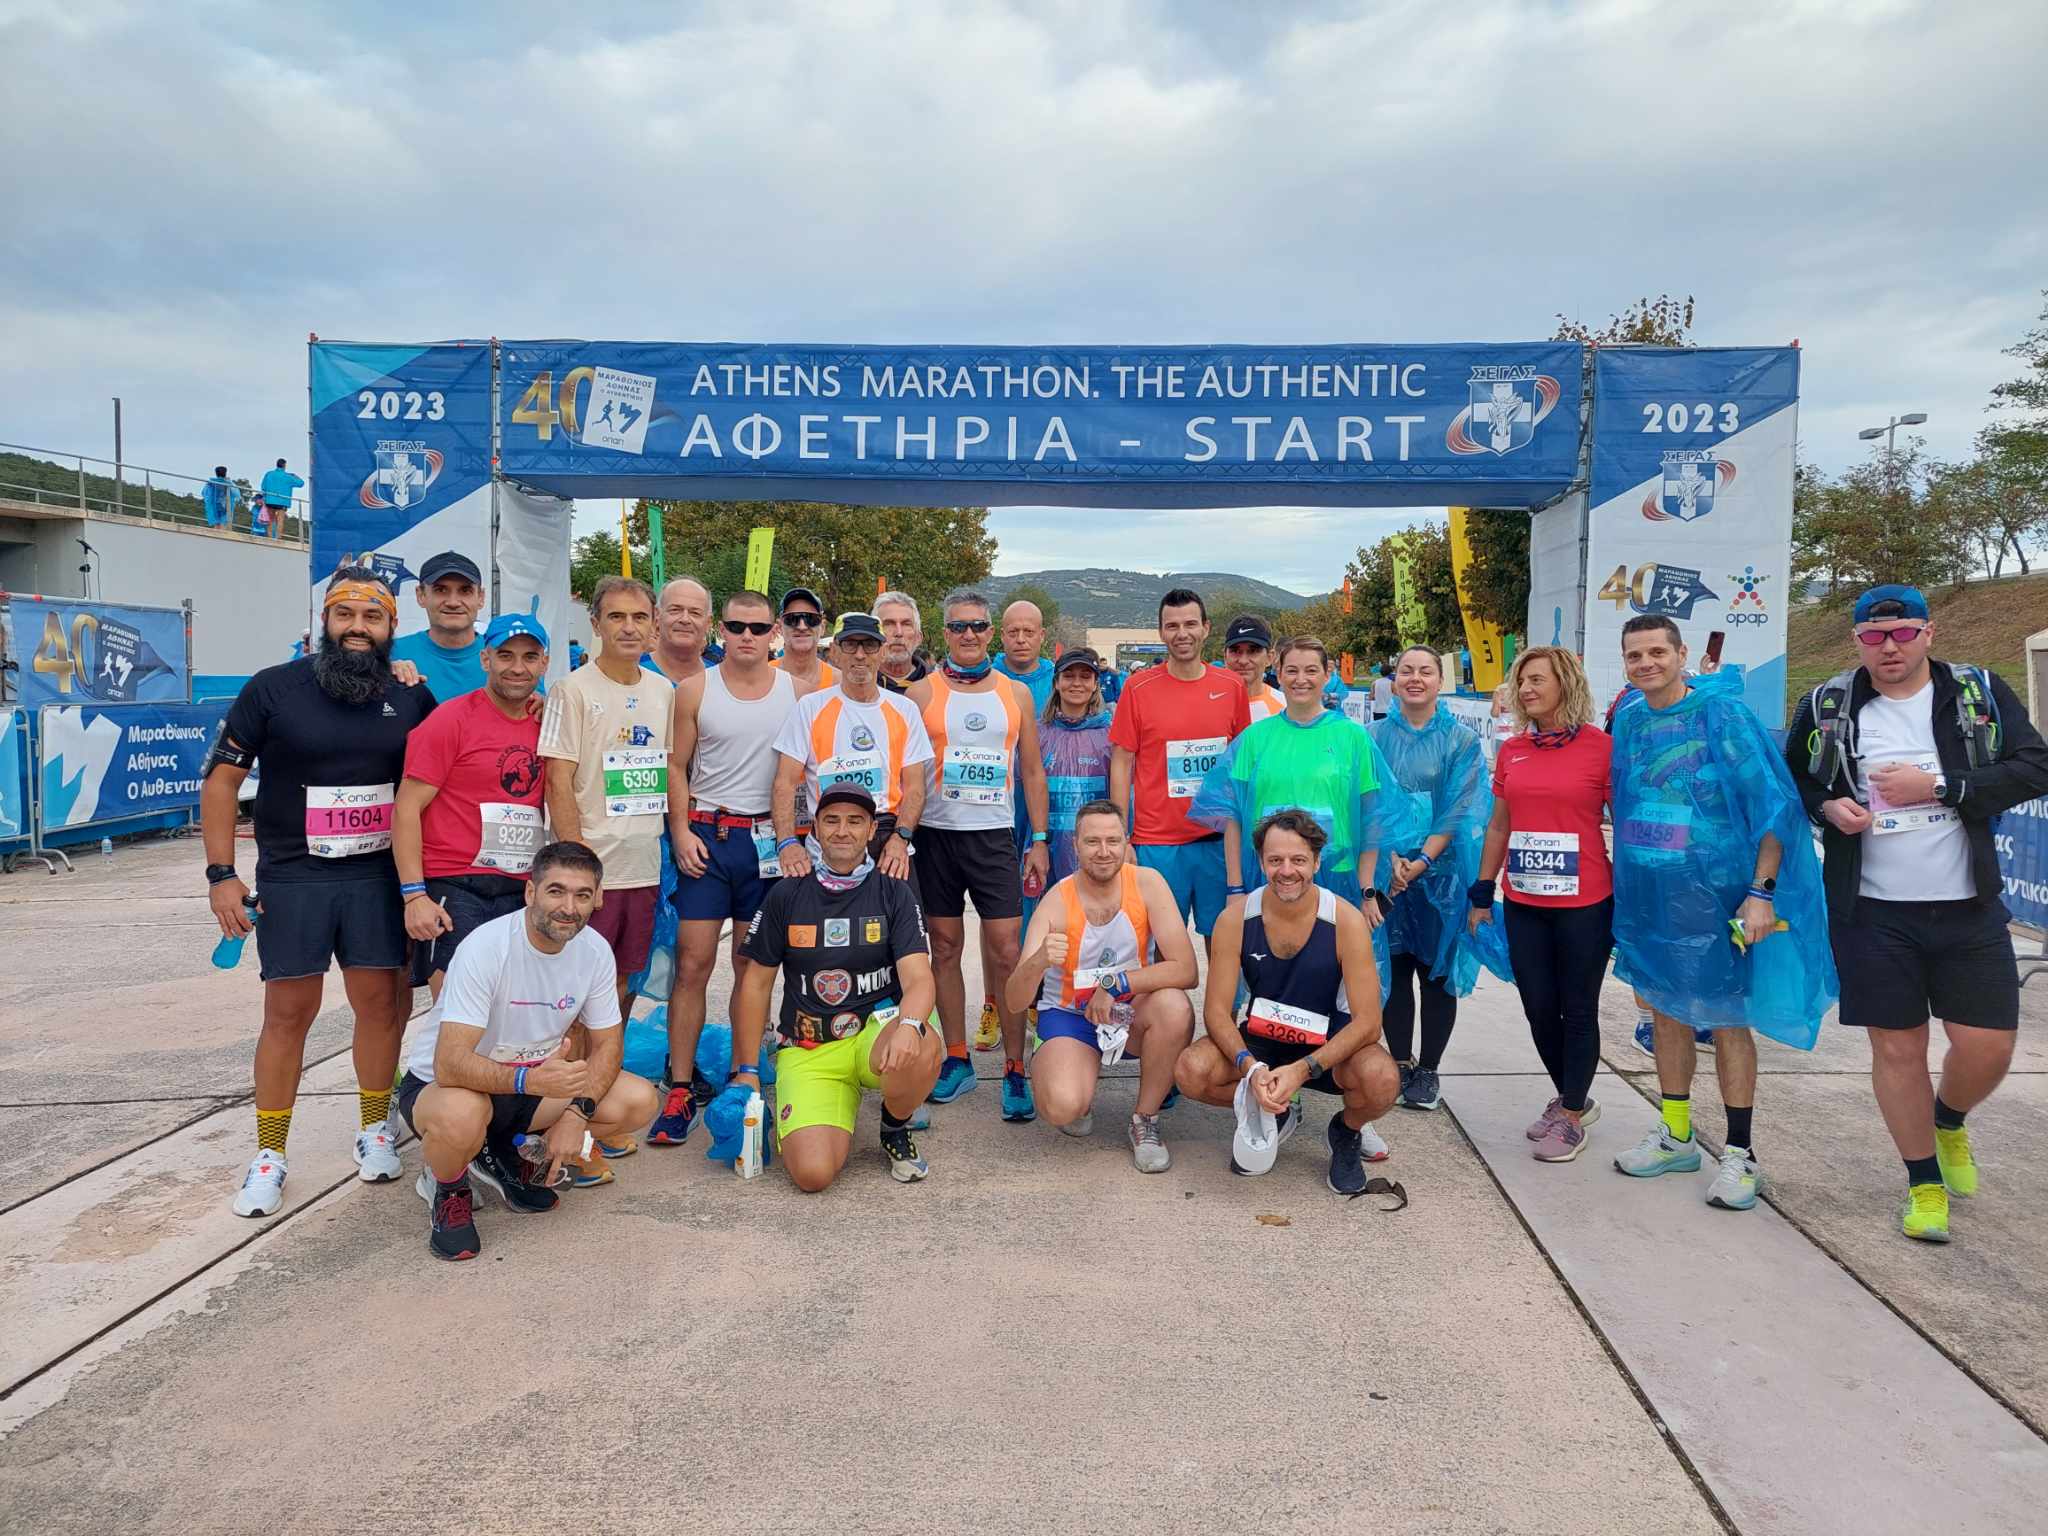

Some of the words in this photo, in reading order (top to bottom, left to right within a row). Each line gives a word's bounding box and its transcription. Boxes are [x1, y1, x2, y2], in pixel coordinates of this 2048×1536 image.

[690, 364, 841, 397] ATHENS
[861, 365, 1100, 399] MARATHON.
[1111, 365, 1185, 398] THE
[1196, 363, 1426, 398] AUTHENTIC
[1471, 365, 1537, 381] ΣΕΓΑΣ
[357, 391, 445, 421] 2023
[1641, 402, 1740, 433] 2023
[679, 413, 1078, 462] ΑΦΕΤΗΡΙΑ
[1184, 415, 1427, 463] START
[1725, 612, 1769, 628] opap
[128, 724, 206, 744] Μαραθώνιος
[127, 752, 178, 772] Αθήνας
[623, 770, 658, 789] 6390
[960, 765, 995, 781] 7645
[127, 782, 138, 800] Ο
[324, 807, 383, 829] 11604
[498, 825, 534, 846] 9322
[1517, 851, 1566, 870] 16344
[856, 966, 893, 996] MUM
[1265, 1023, 1307, 1044] 3269
